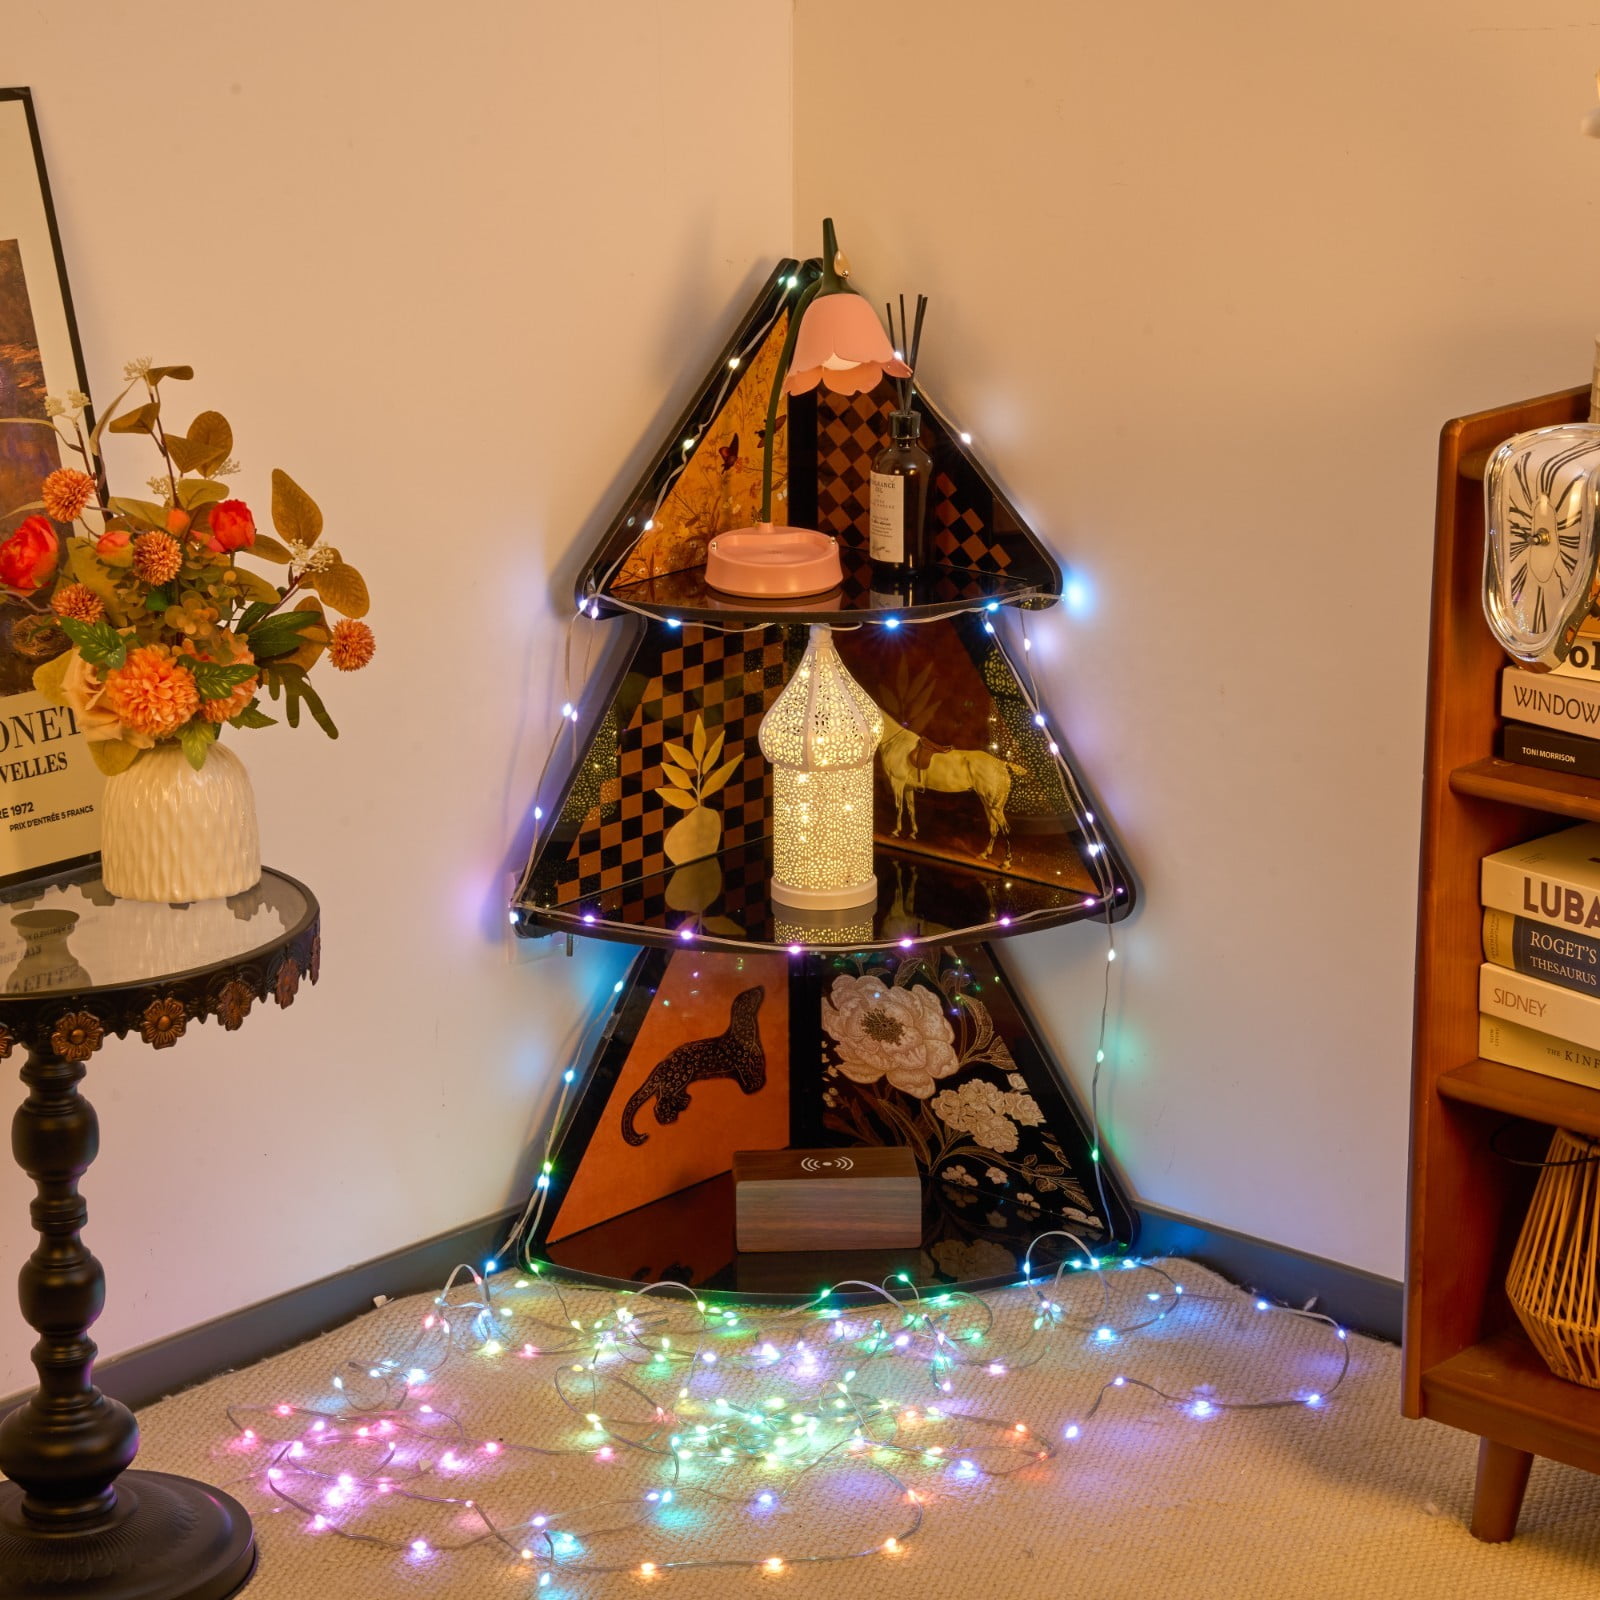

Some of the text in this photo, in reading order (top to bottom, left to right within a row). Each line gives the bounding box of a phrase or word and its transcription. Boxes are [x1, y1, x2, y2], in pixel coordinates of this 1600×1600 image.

[1514, 685, 1600, 724] WINDOW
[1522, 747, 1576, 763] TONI MORRISON
[9, 805, 94, 832] PRIX D'ENTRÉE 5 FRANCS
[11, 802, 35, 817] 1972
[1530, 931, 1597, 964] ROGET'S
[1530, 956, 1597, 985] THESAURUS
[1493, 988, 1547, 1017] SIDNEY
